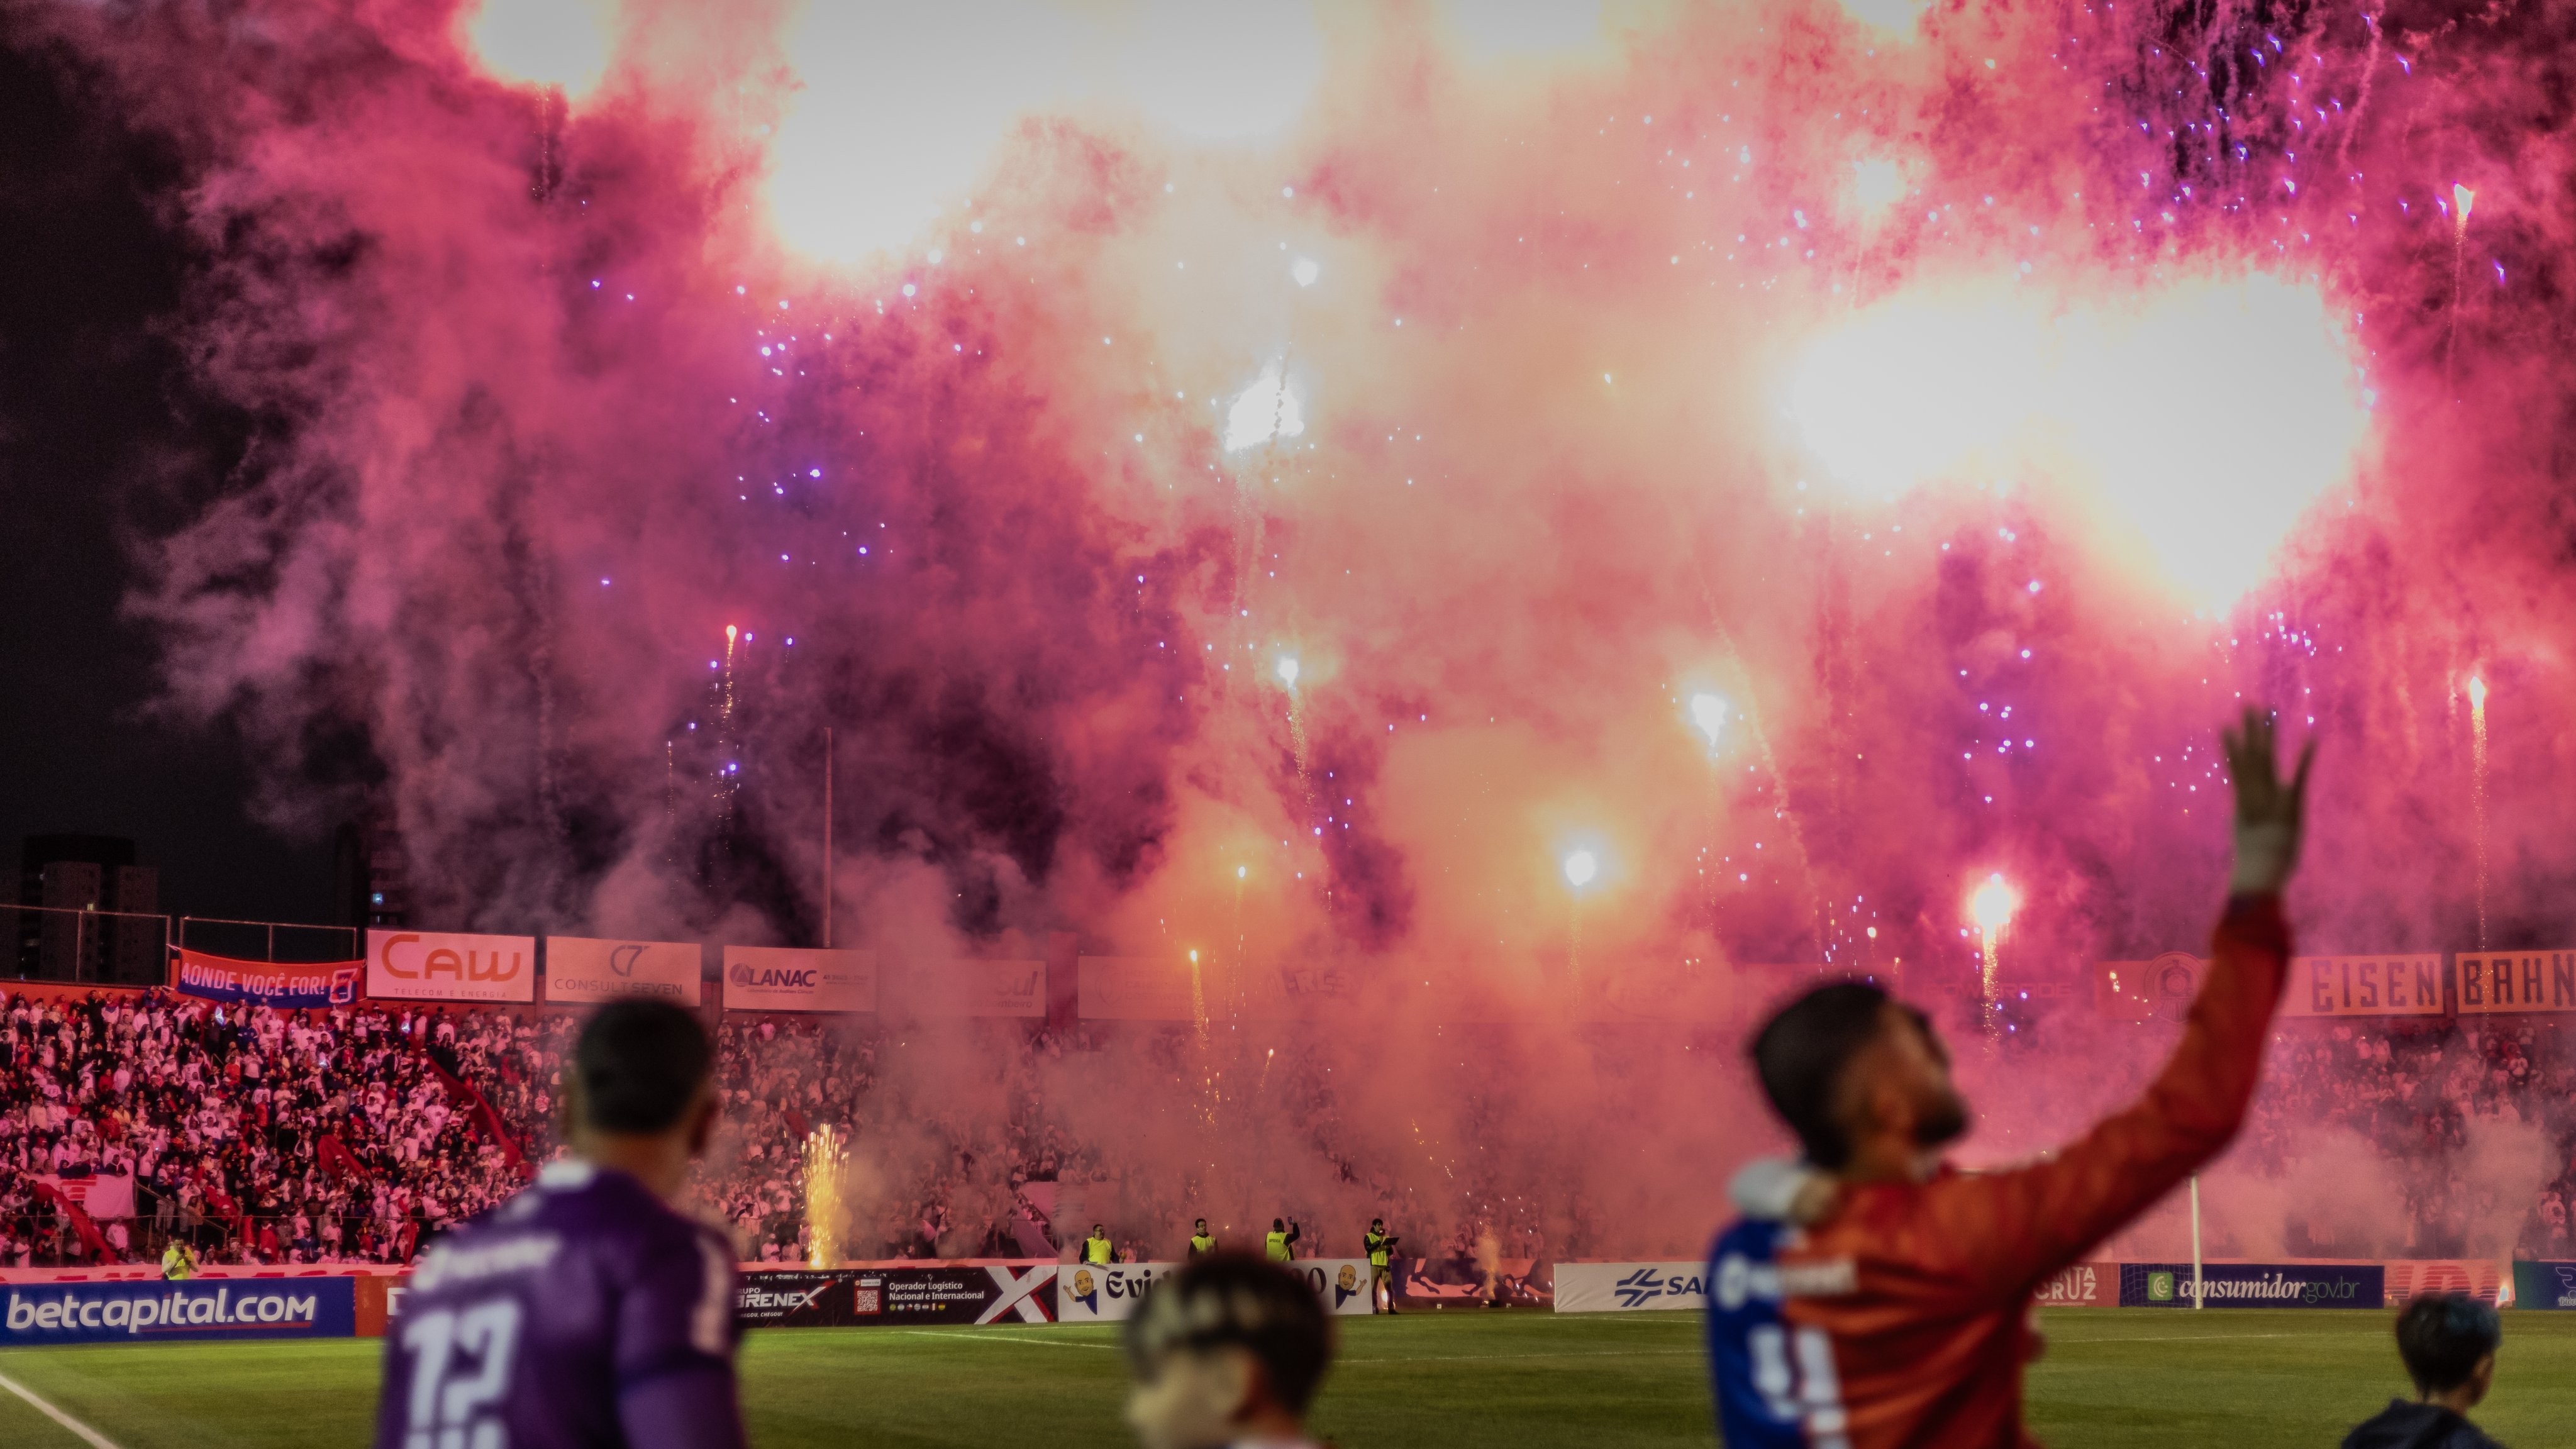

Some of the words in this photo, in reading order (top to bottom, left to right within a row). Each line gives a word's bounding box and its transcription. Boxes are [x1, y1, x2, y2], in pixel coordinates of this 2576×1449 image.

[181, 962, 237, 991] AONDE
[242, 972, 286, 996] VOCÊ
[289, 975, 326, 996] FOR!
[748, 969, 817, 987] LANAC
[2311, 959, 2436, 1013] EISEN
[2463, 953, 2576, 1007] BAHN
[394, 988, 443, 996] TELECOM
[1923, 982, 2072, 999] POWRADE
[889, 1282, 926, 1291] Operador
[928, 1282, 963, 1291] Logístico
[889, 1292, 924, 1300] Nacional
[932, 1291, 984, 1300] Internacional
